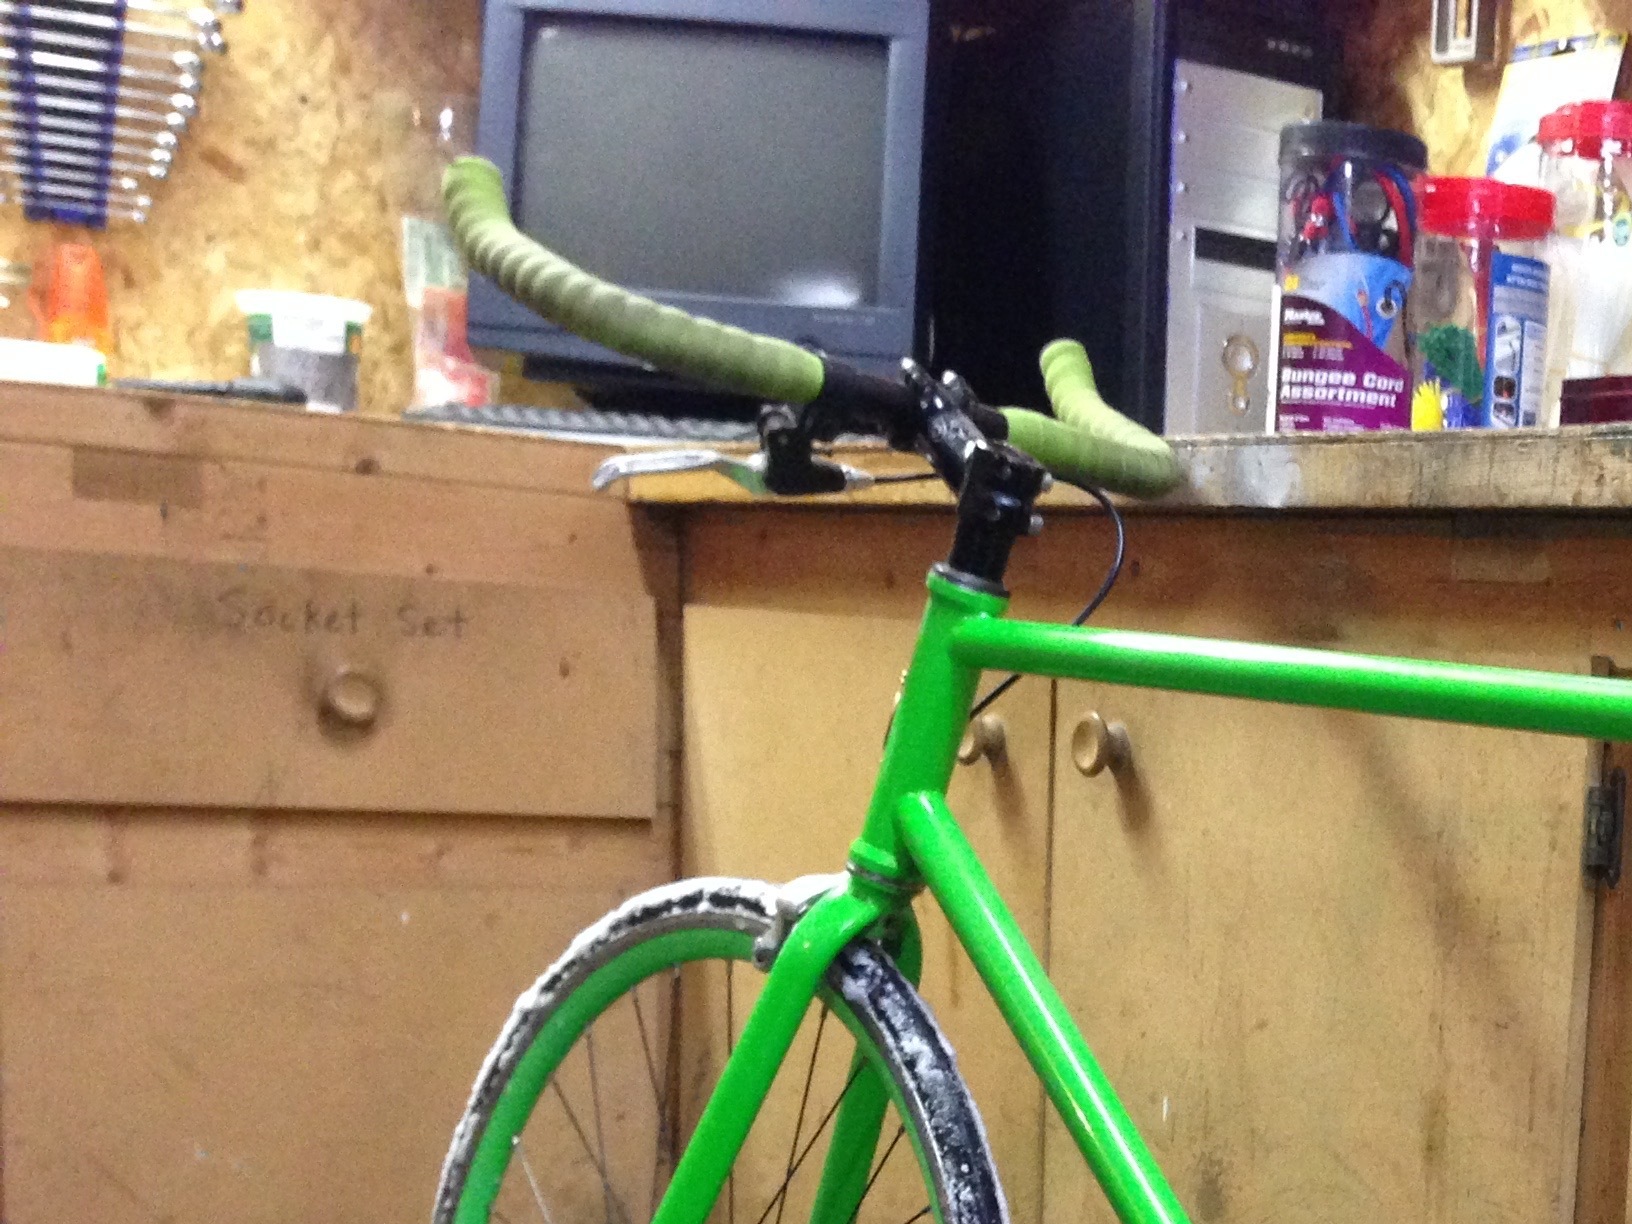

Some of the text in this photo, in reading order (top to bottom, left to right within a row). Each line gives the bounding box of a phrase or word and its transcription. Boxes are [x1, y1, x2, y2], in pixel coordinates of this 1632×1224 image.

[1281, 367, 1404, 393] Bungee Cord
[1279, 383, 1396, 408] Assortment
[216, 584, 469, 639] Socket Set
